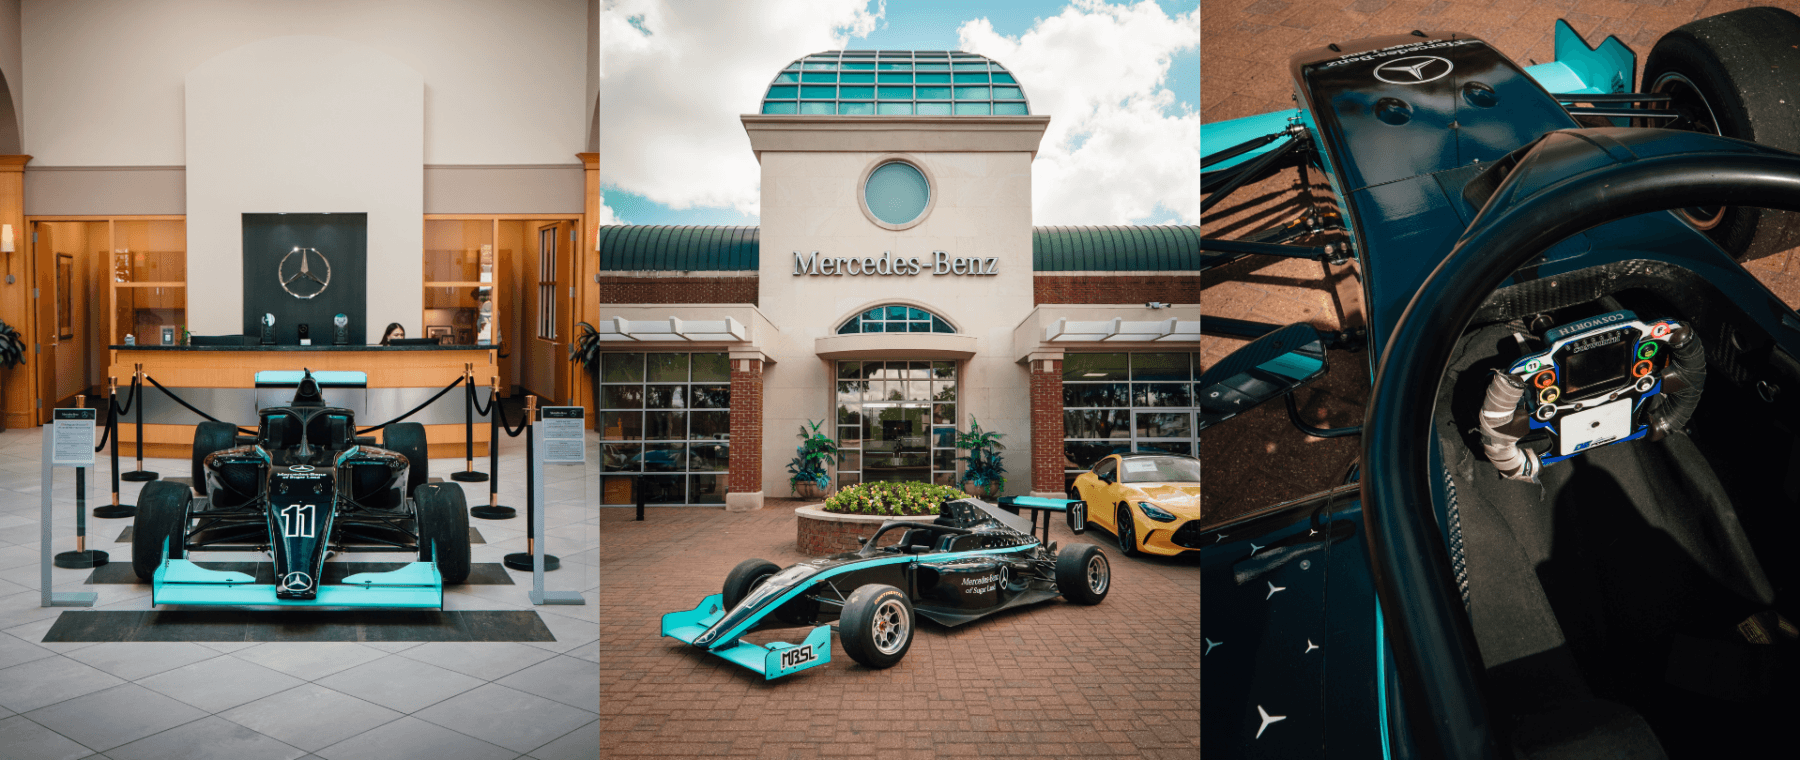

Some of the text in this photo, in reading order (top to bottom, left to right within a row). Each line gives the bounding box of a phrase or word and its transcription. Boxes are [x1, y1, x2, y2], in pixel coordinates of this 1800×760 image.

[1326, 40, 1466, 68] Mercedes-Benz
[792, 250, 1000, 276] Mercedes-Benz
[1558, 313, 1625, 336] COSWORTH
[281, 504, 316, 539] 11
[1072, 503, 1084, 531] 11
[781, 644, 817, 669] MBSL
